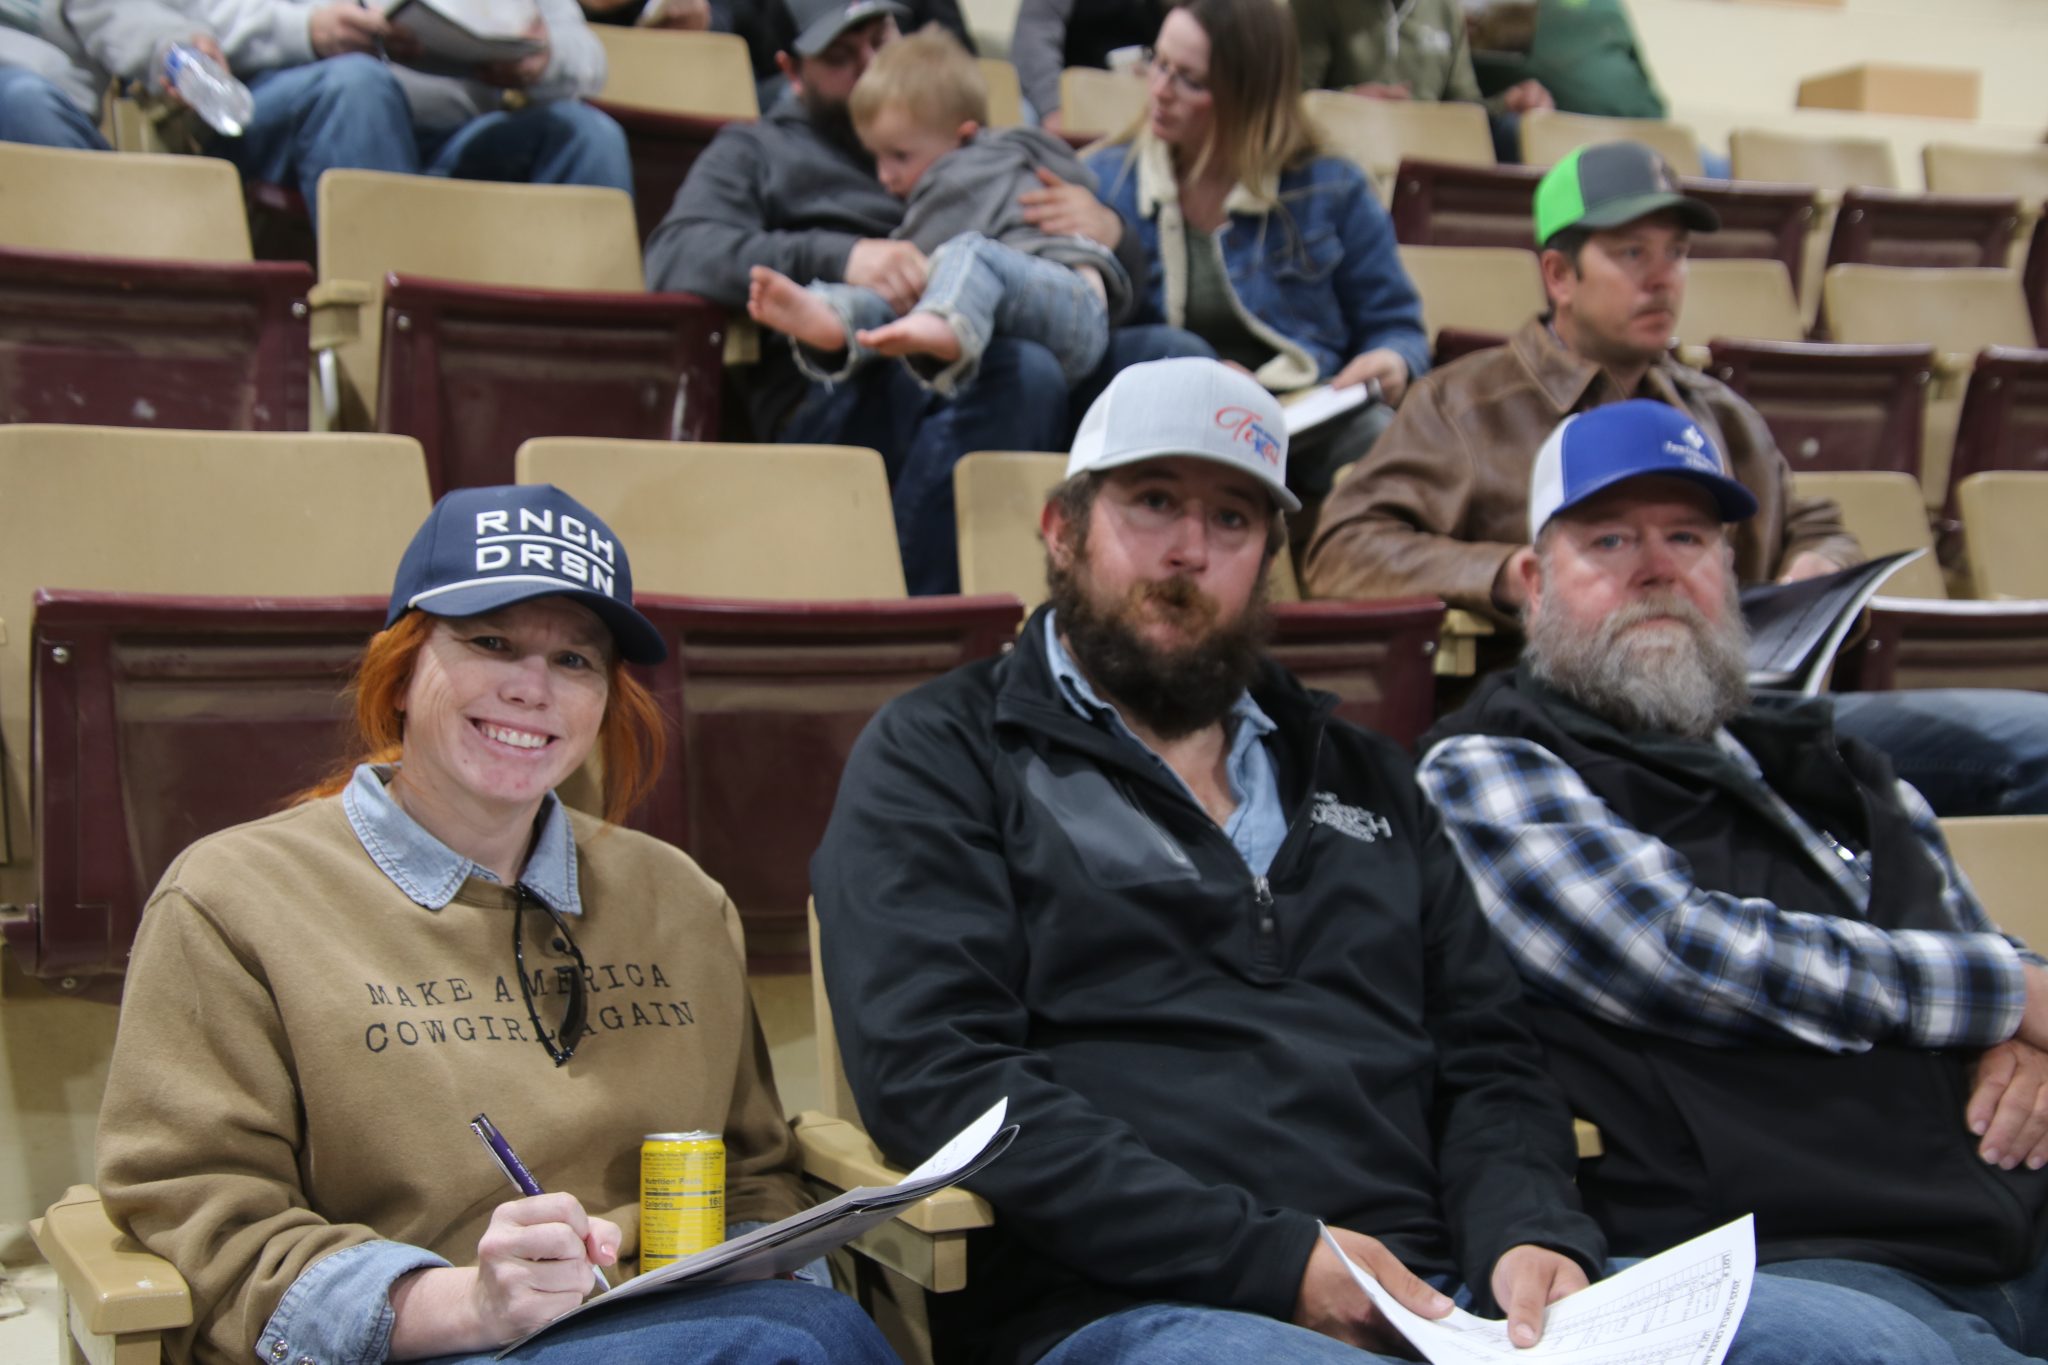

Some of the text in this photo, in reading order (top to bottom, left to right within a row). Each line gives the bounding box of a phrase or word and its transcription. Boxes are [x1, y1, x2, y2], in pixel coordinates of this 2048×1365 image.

[476, 507, 615, 565] RNCH
[476, 543, 615, 599] DRSN
[365, 963, 671, 1008] MAKE AMERICA
[645, 1177, 676, 1185] Nutrition
